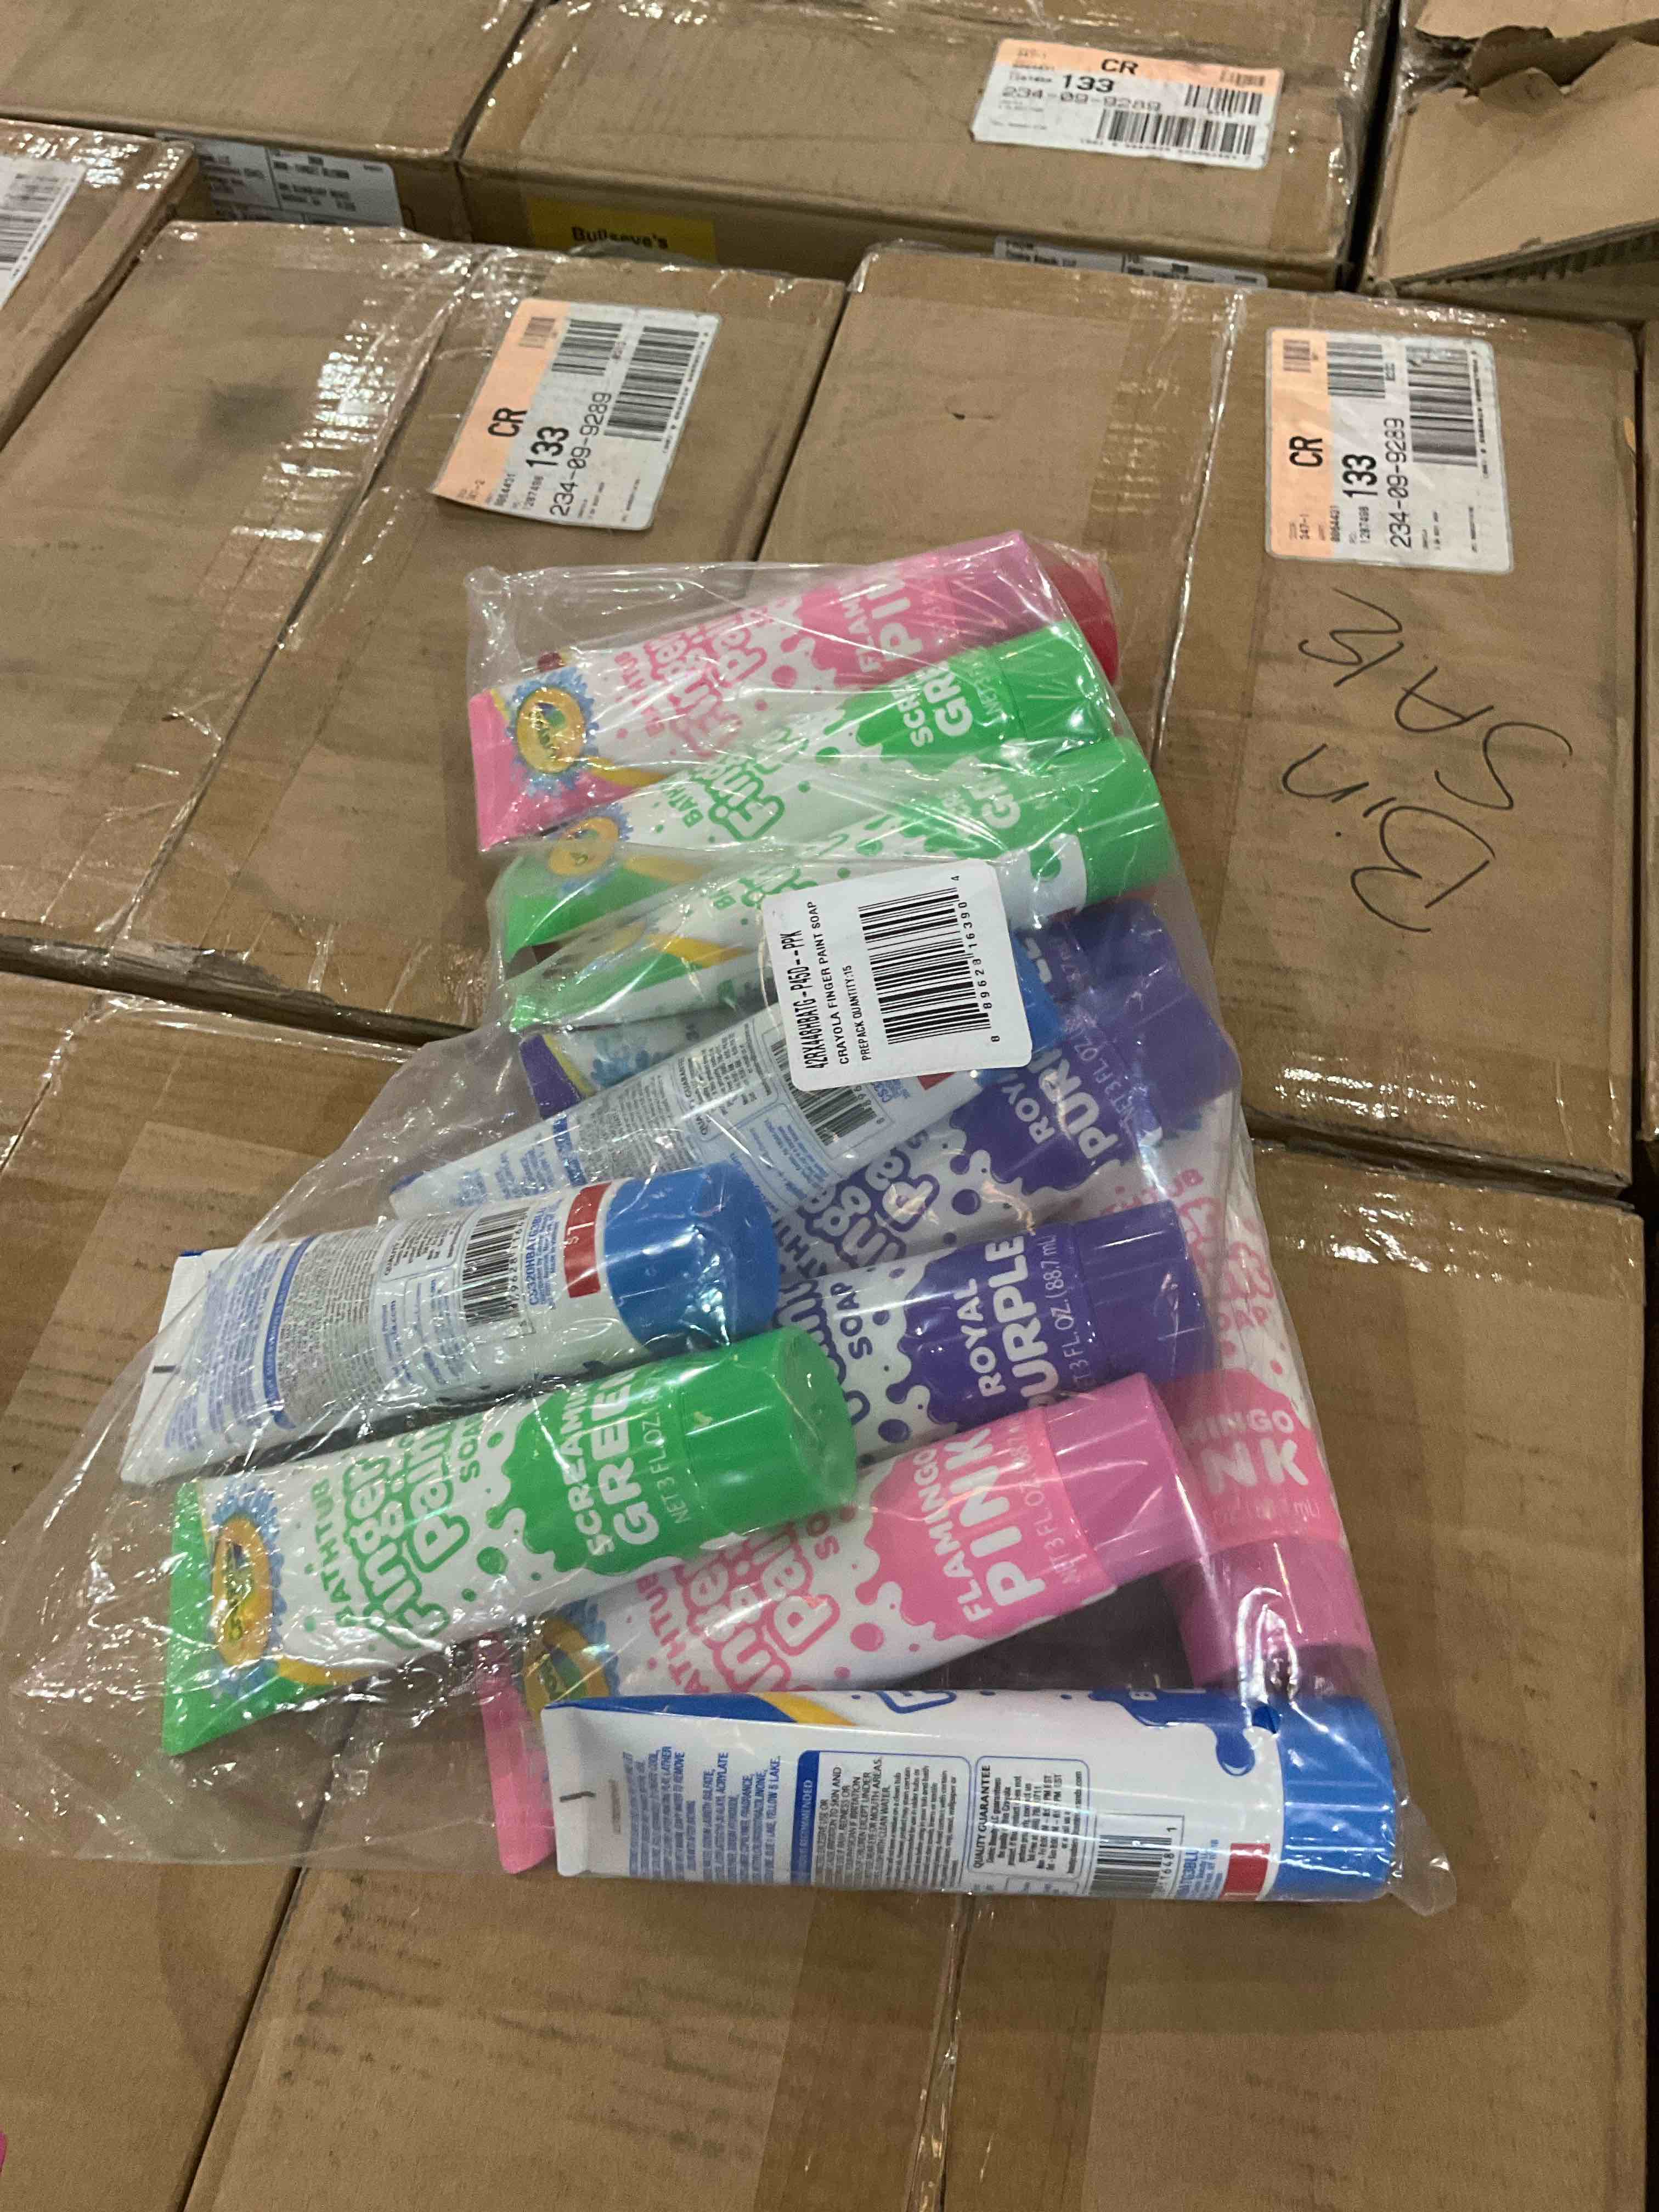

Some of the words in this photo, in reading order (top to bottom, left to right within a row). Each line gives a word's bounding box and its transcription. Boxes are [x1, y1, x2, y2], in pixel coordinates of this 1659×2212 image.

[1063, 74, 1115, 94] 133
[1101, 58, 1139, 75] CR
[487, 407, 527, 438] CR
[526, 426, 569, 467] 133
[550, 392, 612, 517] 234-09-9289
[1289, 436, 1323, 467] CR
[1342, 454, 1379, 498] 133
[1384, 417, 1412, 549] 234-09-9289
[808, 901, 821, 929] SOAP
[816, 932, 830, 968] PAINT
[822, 968, 839, 1010] FINGER
[842, 964, 863, 1020] QUANTITY:15
[830, 1011, 849, 1065] CRAYOLA
[855, 1022, 872, 1062] PREPACK
[991, 1035, 1001, 1043] 8
[831, 1282, 873, 1359] SOAP
[953, 1278, 1006, 1397] ROYAL
[985, 1235, 1059, 1406] URPLE
[657, 1476, 675, 1490] 3
[912, 1448, 993, 1622] FLAMINGO
[944, 1429, 1046, 1606] PINK
[769, 1756, 781, 1782] LAKE.
[832, 1767, 842, 1787] AND
[862, 1772, 870, 1802] UNDER
[978, 1765, 991, 1832] GUARANTEE
[973, 1834, 986, 1869] QUALITY
